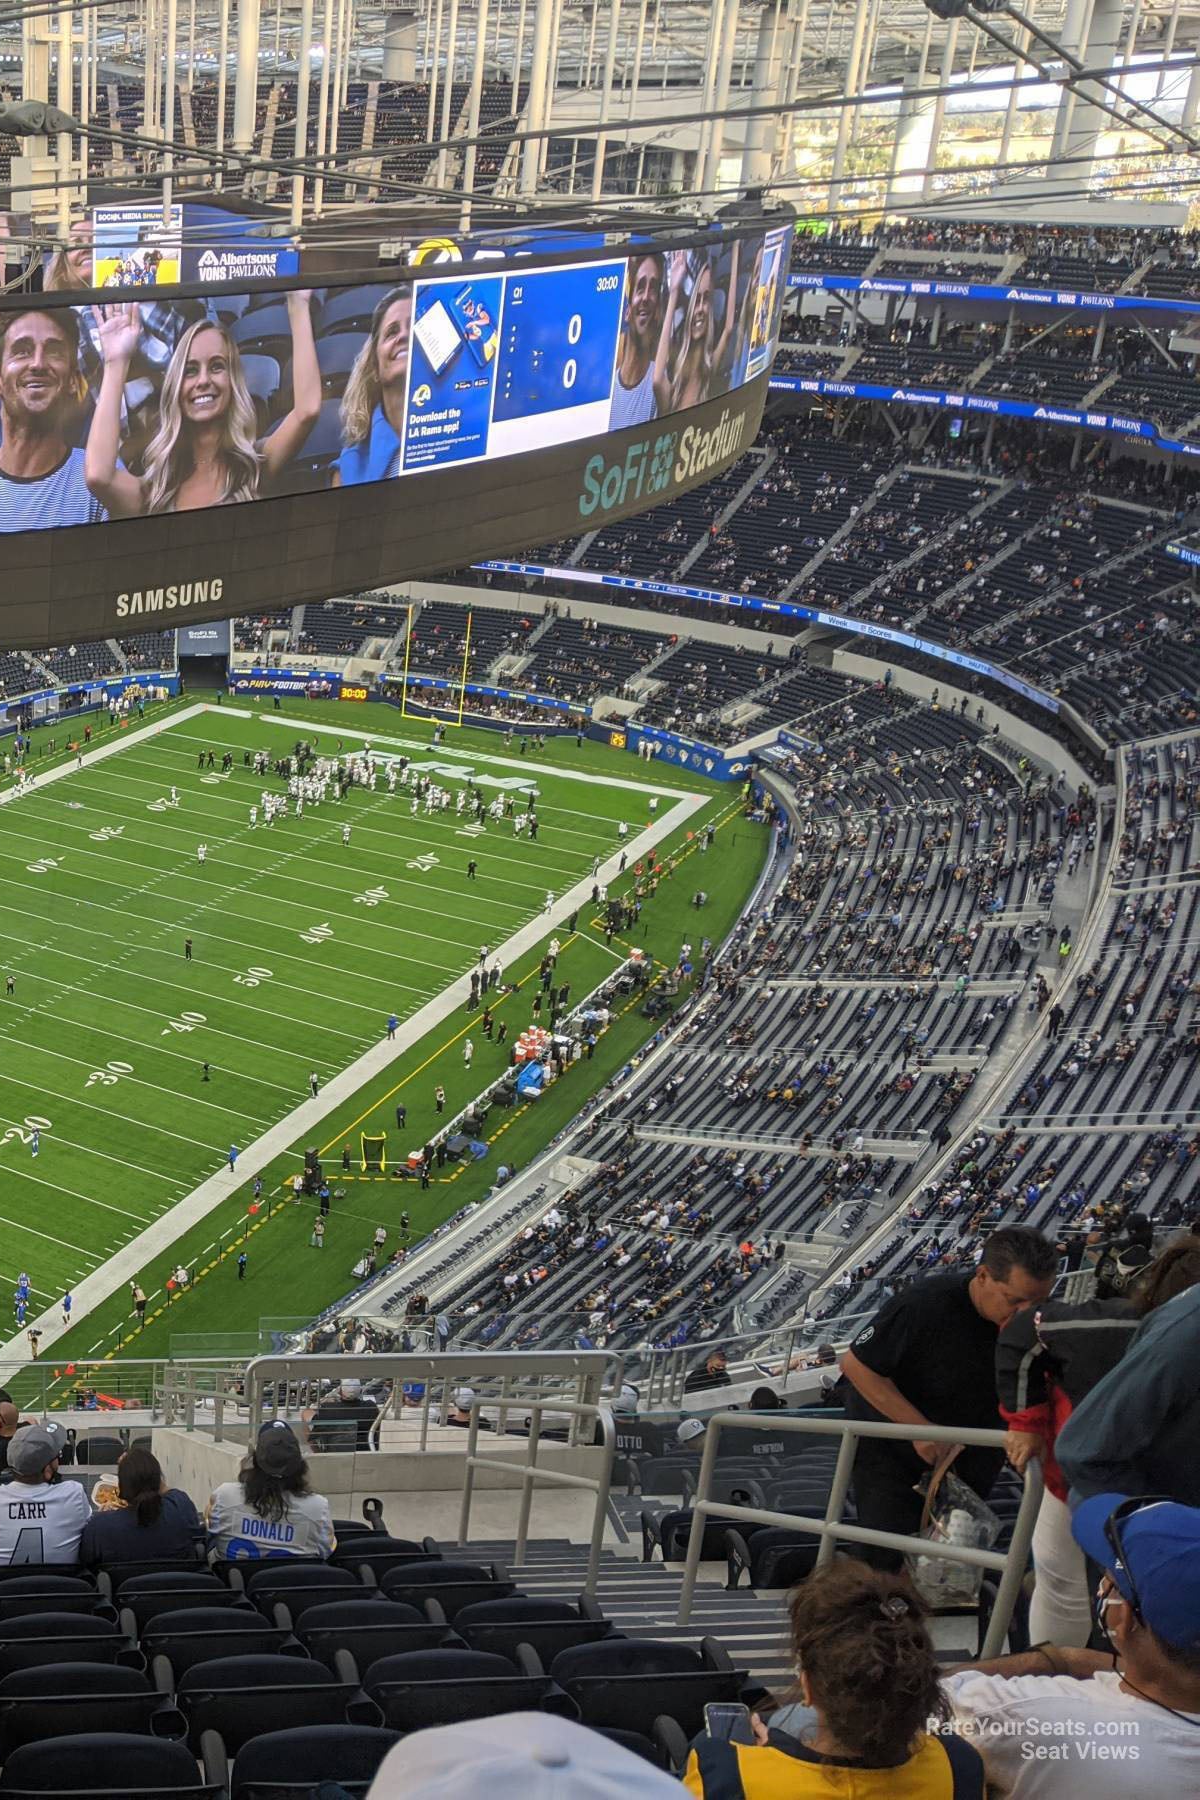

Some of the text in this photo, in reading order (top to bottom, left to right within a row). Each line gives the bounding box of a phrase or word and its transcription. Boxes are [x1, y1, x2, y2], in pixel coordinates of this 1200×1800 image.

[219, 253, 277, 266] Albertsons
[199, 264, 276, 282] VONS PAVILIONS
[791, 275, 823, 286] PAVILIONS
[596, 276, 619, 291] 30:00
[911, 283, 931, 293] VONS
[935, 284, 970, 295] PAVILIONS
[1057, 294, 1076, 304] VONS
[1081, 295, 1114, 308] PAVILIONS
[567, 314, 582, 344] 0
[562, 359, 577, 388] 0
[800, 381, 855, 395] VONS PAVILIONS
[945, 395, 963, 406] VONS
[967, 397, 999, 410] PAVILIONS
[409, 408, 461, 424] Download the
[1087, 414, 1107, 426] VONS
[408, 421, 460, 438] LA Rams app!
[579, 408, 746, 516] SoFi Stadium
[116, 579, 223, 617] SAMSUNG
[828, 614, 848, 628] Week
[867, 625, 892, 639] Scores
[341, 687, 367, 699] 30:00
[612, 734, 625, 746] 25
[200, 770, 231, 786] 10
[88, 825, 125, 841] 30
[455, 822, 488, 838] 10
[26, 856, 64, 873] 40
[406, 855, 441, 871] 20
[353, 888, 390, 907] 30
[299, 924, 334, 945] 40
[232, 966, 274, 988] 50
[168, 1011, 208, 1035] 40
[88, 1060, 134, 1086] 30
[4, 1116, 52, 1145] 20
[617, 1435, 642, 1449] OTTO
[8, 1502, 48, 1520] CARR
[241, 1516, 295, 1542] DONALD
[9, 1527, 43, 1566] 4
